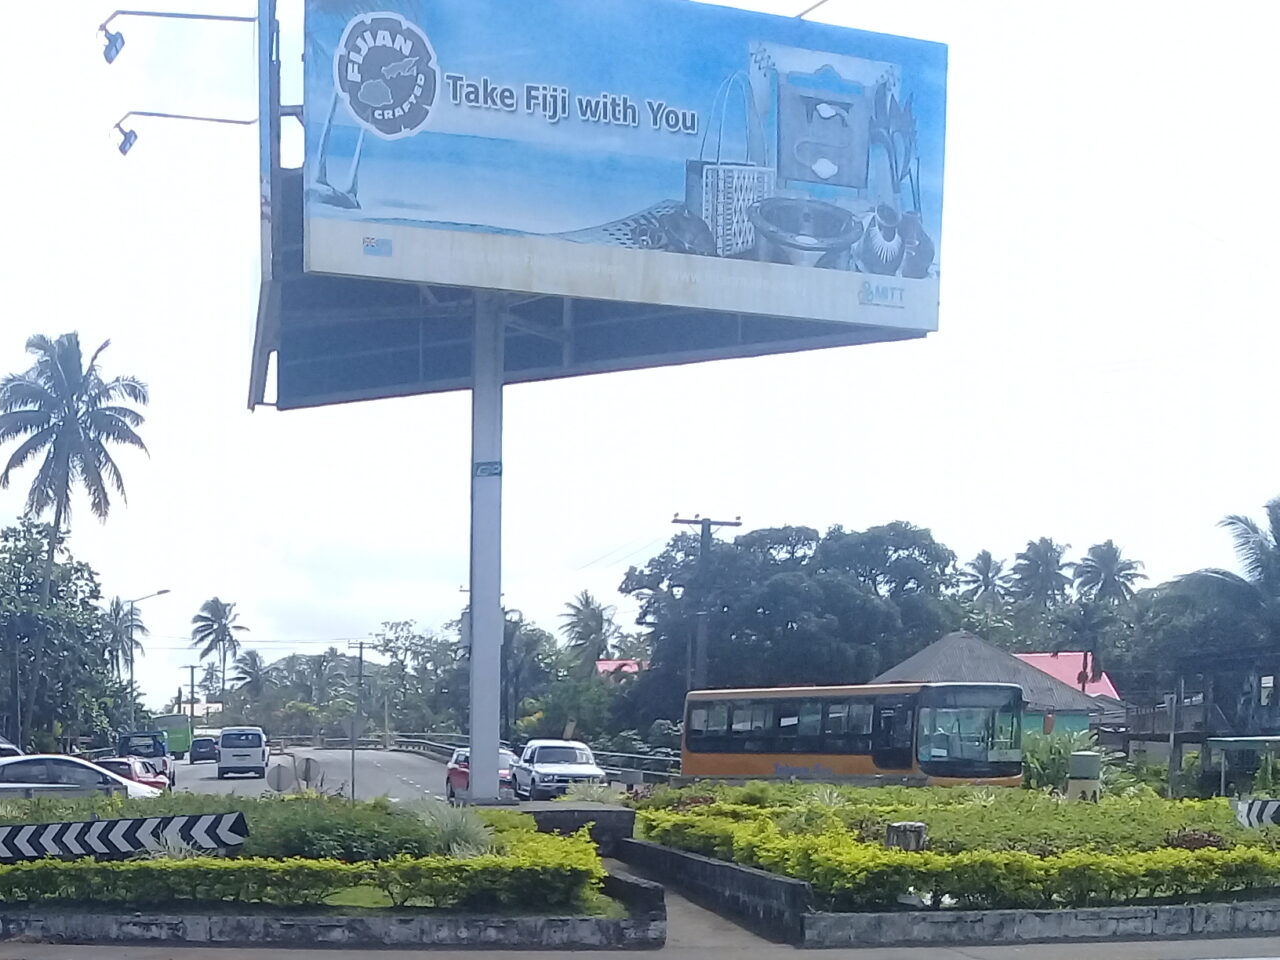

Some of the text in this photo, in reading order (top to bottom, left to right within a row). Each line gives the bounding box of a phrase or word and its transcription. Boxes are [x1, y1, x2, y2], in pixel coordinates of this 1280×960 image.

[346, 29, 414, 83] FIJIAN
[373, 73, 425, 120] CRAFTED
[445, 73, 697, 132] Take Fiji with You
